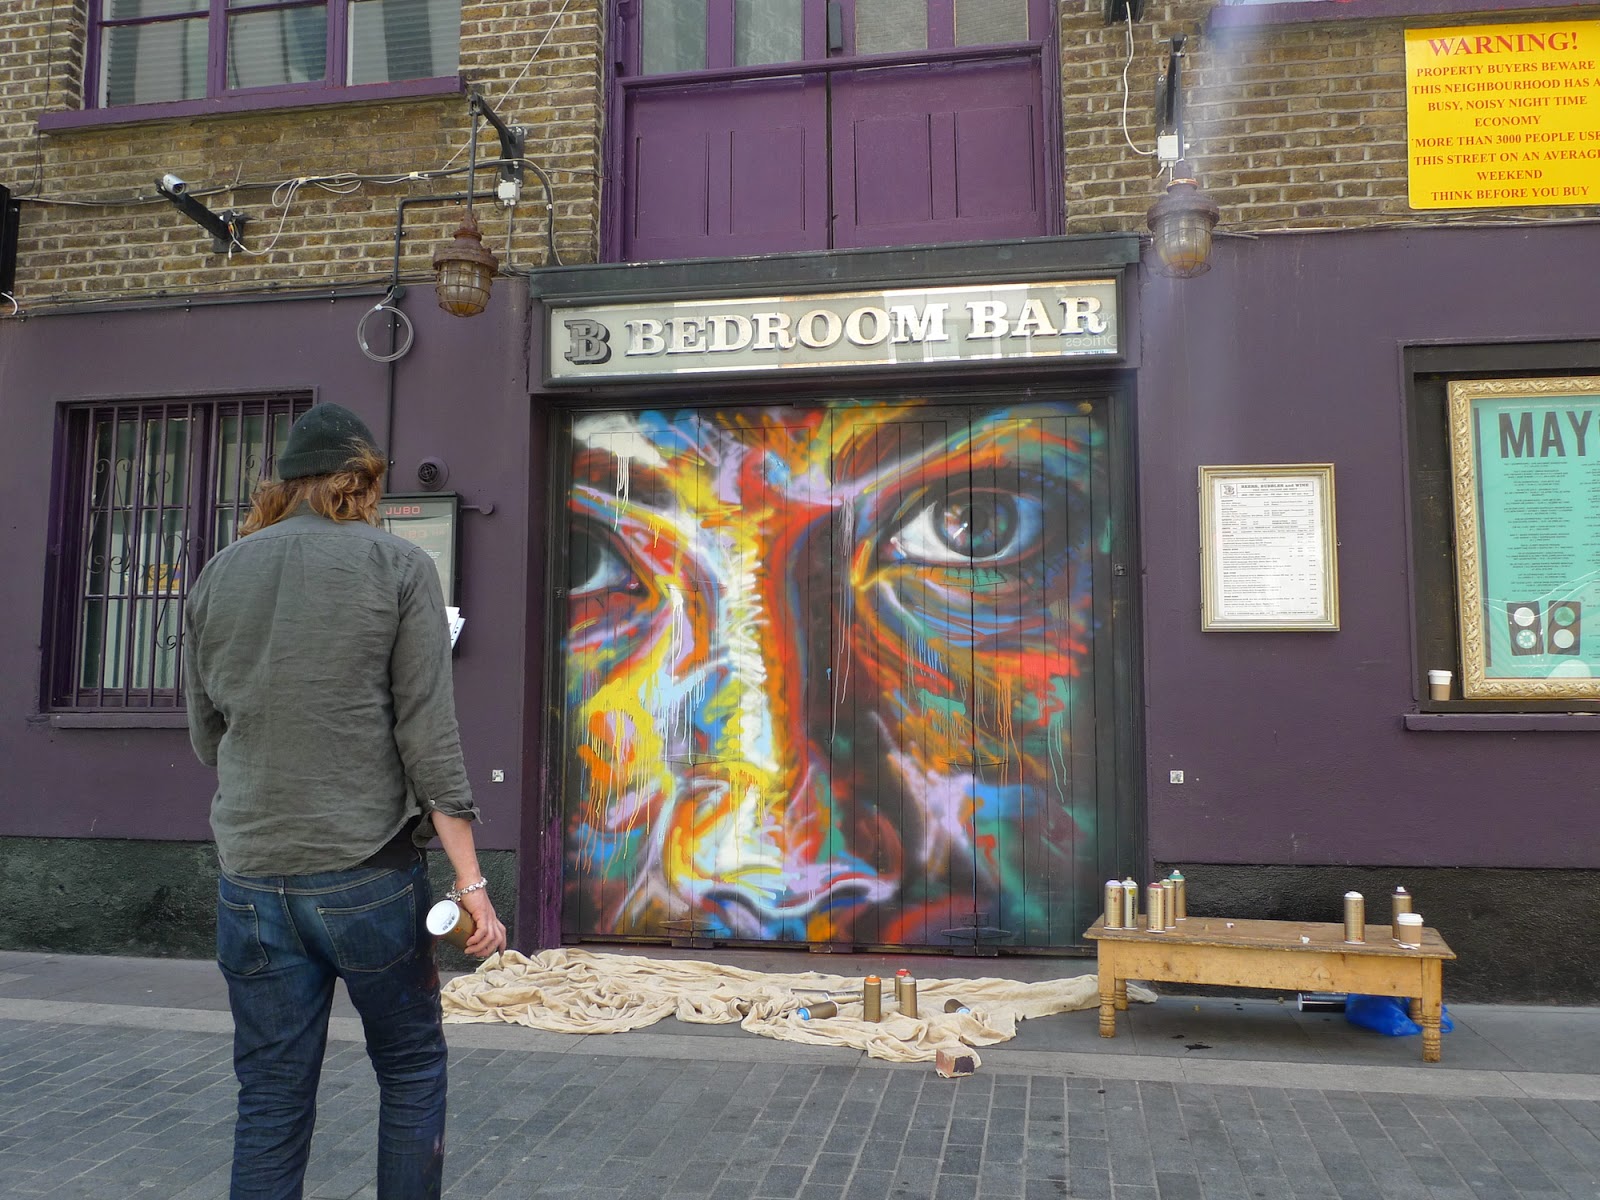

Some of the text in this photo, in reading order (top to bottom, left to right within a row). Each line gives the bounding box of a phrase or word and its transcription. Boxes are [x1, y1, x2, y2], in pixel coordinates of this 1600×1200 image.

[1428, 32, 1578, 56] WARNING!
[1416, 60, 1596, 78] PROPERTY BUYERS BEWARE
[1412, 85, 1442, 95] THIS
[1444, 79, 1561, 93] NEIGHBOURHOOD
[1564, 77, 1590, 88] HAS
[1427, 95, 1588, 112] BUSY, NOISY NIGHT TIME
[1474, 115, 1542, 127] ECONOMY
[1415, 130, 1600, 148] MORE THAN 3000 PEOPLE USE
[1414, 155, 1444, 166] THIS
[1447, 153, 1497, 165] STREET
[1500, 152, 1519, 162] ON
[1522, 151, 1541, 161] AN
[1476, 169, 1543, 181] WEEKEND
[1431, 185, 1590, 201] THINK BEFORE YOU BUY
[564, 297, 1107, 364] B BEDROOM BAR
[1498, 410, 1593, 458] MAY
[385, 506, 421, 515] JUBO
